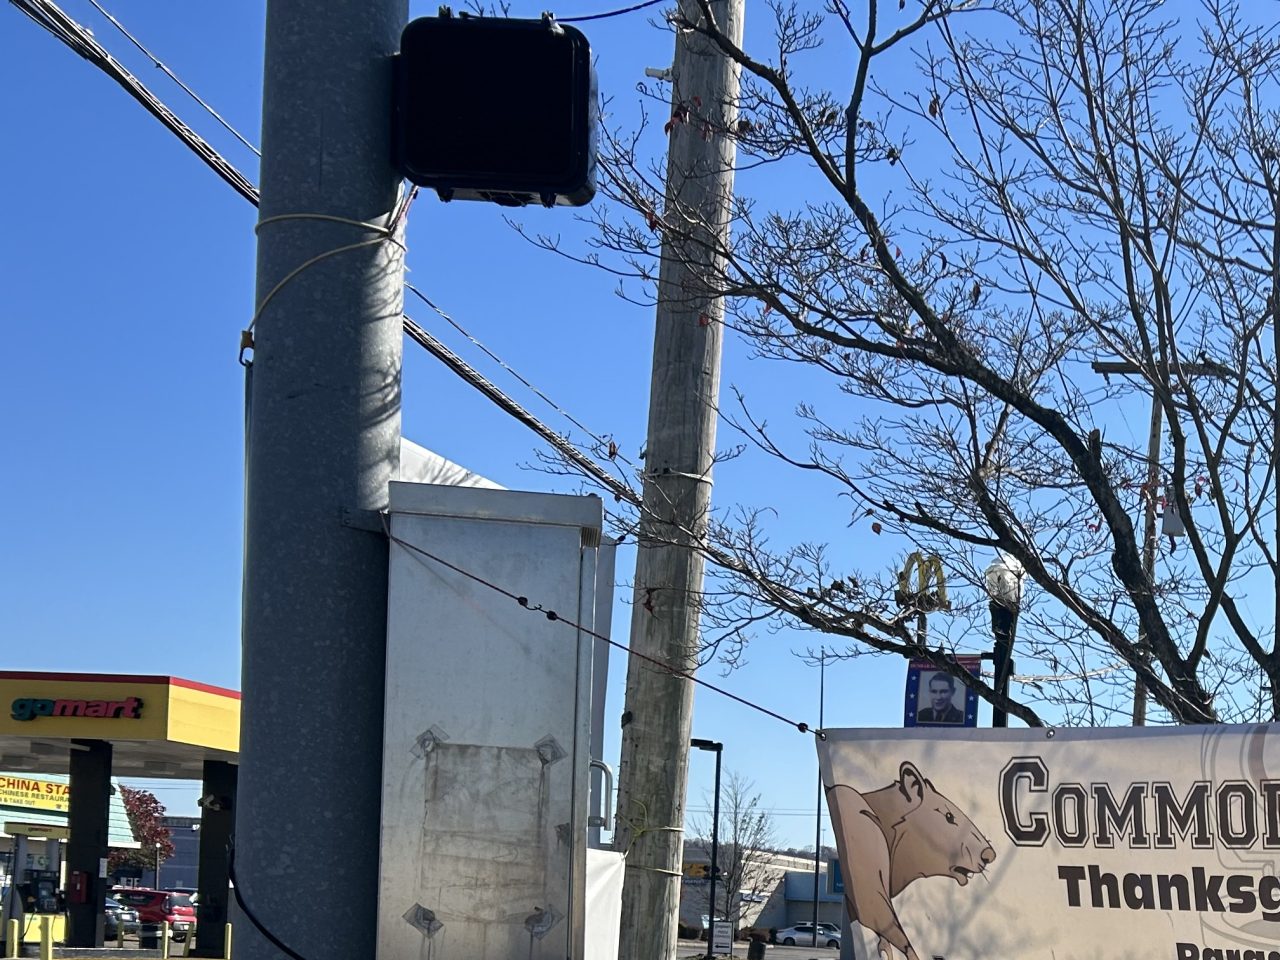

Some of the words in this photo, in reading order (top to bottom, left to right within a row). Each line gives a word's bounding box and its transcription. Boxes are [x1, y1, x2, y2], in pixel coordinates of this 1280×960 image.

[11, 697, 143, 721] gomart
[0, 777, 40, 793] CHINA
[45, 783, 72, 796] STA
